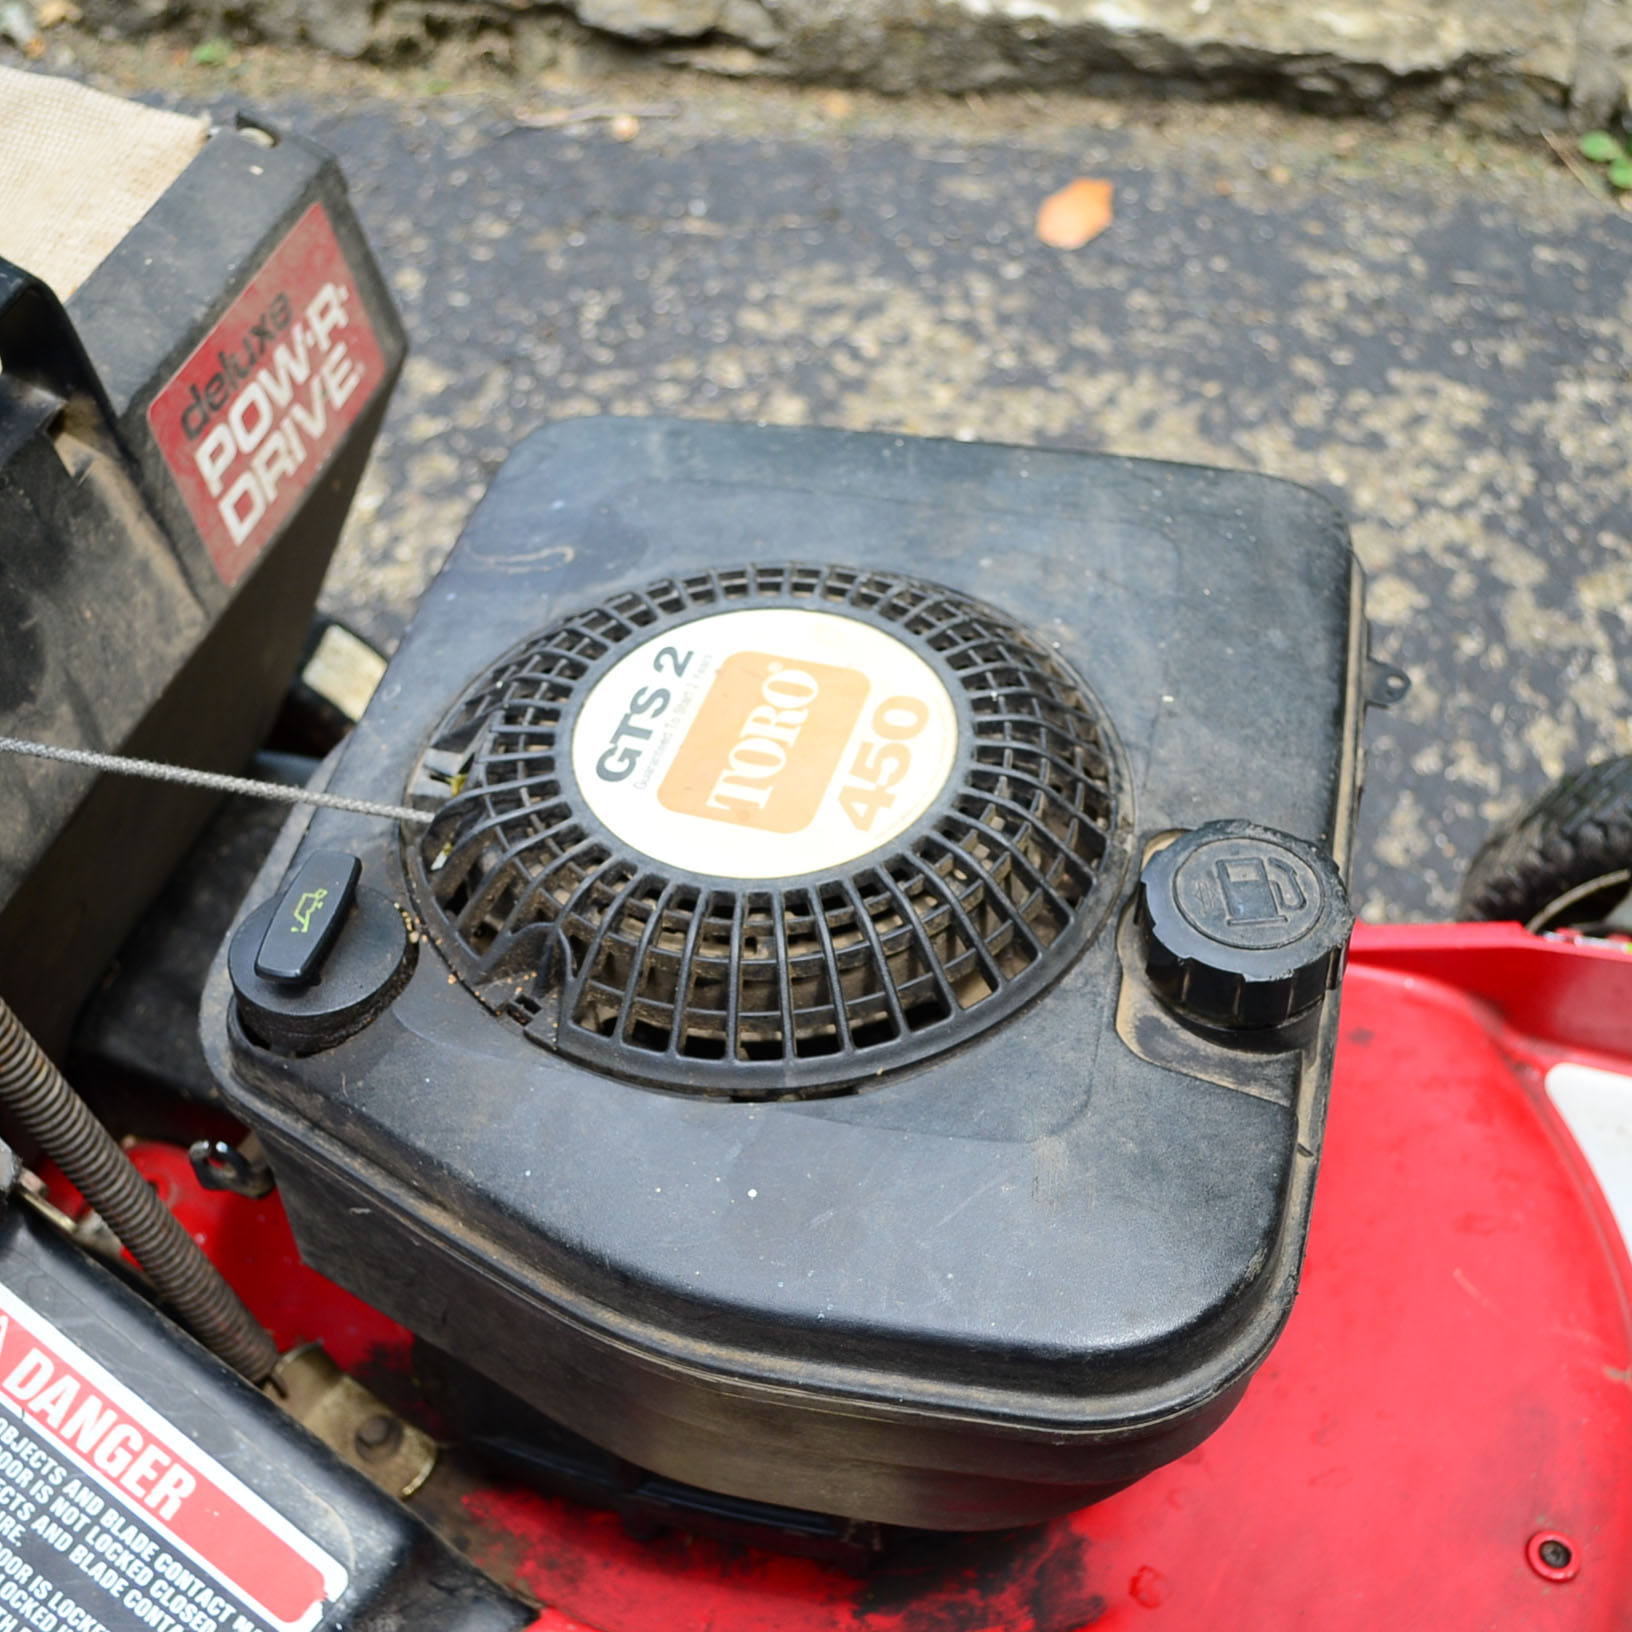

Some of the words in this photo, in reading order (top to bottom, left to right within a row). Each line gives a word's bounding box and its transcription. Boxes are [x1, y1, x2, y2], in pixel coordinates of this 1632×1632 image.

[181, 291, 292, 440] deluxe
[219, 342, 361, 547] DRIVE
[596, 686, 672, 782] GTS
[653, 646, 695, 678] 2
[706, 668, 820, 810] TORO
[838, 695, 930, 832] 450
[2, 1347, 196, 1521] DANGER
[0, 1445, 34, 1488] OOR
[29, 1479, 54, 1504] IS
[49, 1496, 91, 1532] NOT
[85, 1525, 154, 1587] LOCKED
[149, 1578, 217, 1632] CLOSED
[0, 1542, 34, 1584] OOR
[28, 1575, 53, 1600] IS
[0, 1573, 58, 1632] OCKED
[30, 1515, 73, 1552] AND
[68, 1544, 129, 1598] BLADE
[62, 1479, 105, 1516] AND
[100, 1508, 160, 1561] BLADE
[154, 1552, 237, 1623] CONTACT
